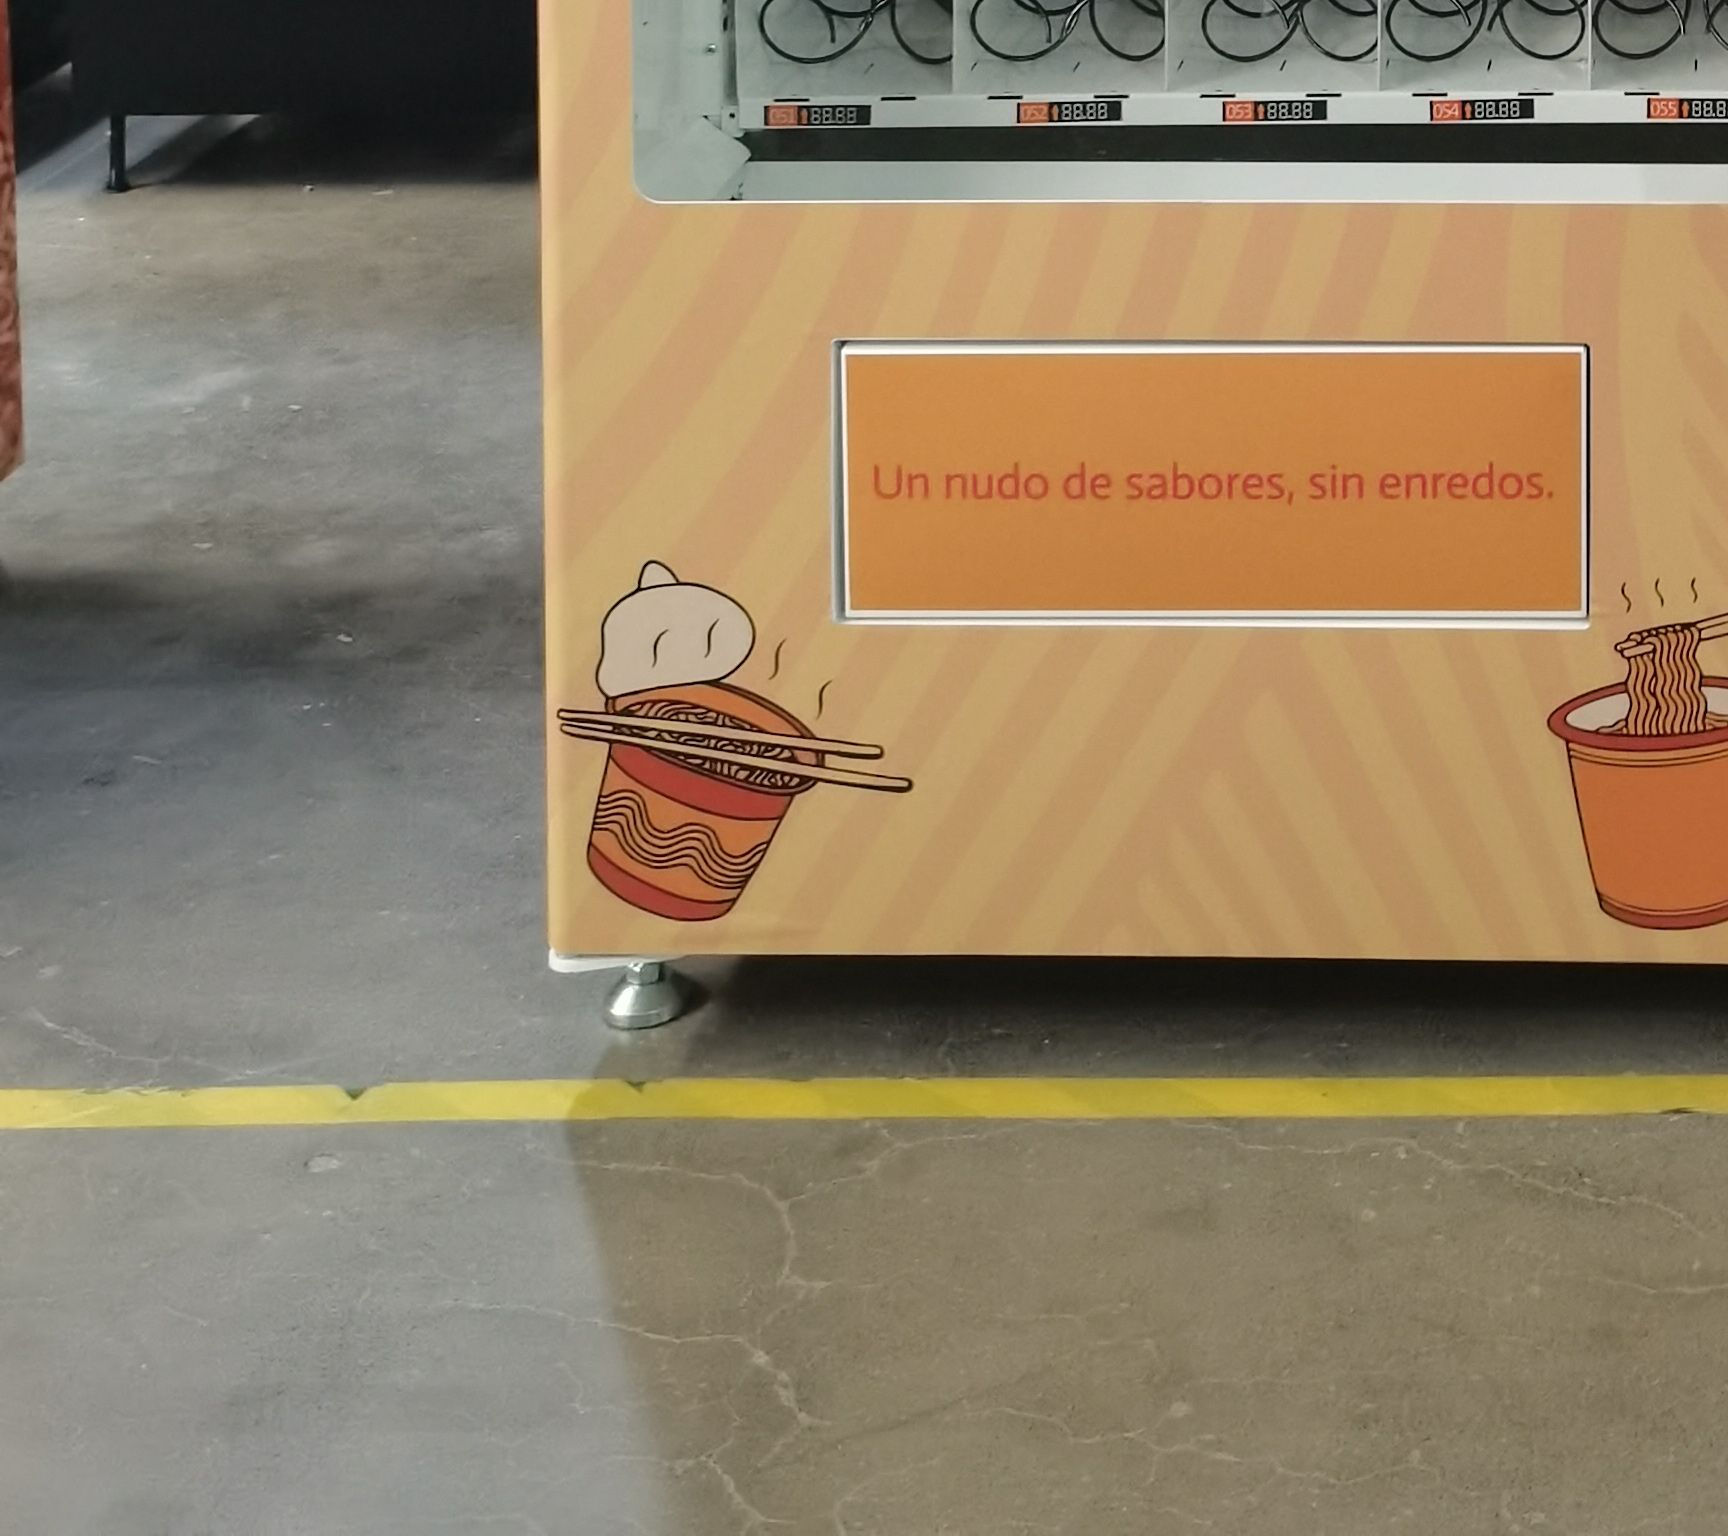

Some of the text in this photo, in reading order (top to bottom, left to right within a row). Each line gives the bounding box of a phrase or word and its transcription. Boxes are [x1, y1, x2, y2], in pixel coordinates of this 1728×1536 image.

[1226, 103, 1253, 119] 053
[1432, 102, 1459, 119] 054
[1650, 101, 1677, 117] 055
[872, 464, 1554, 506] Un nudo de sabores, sin enredos.
